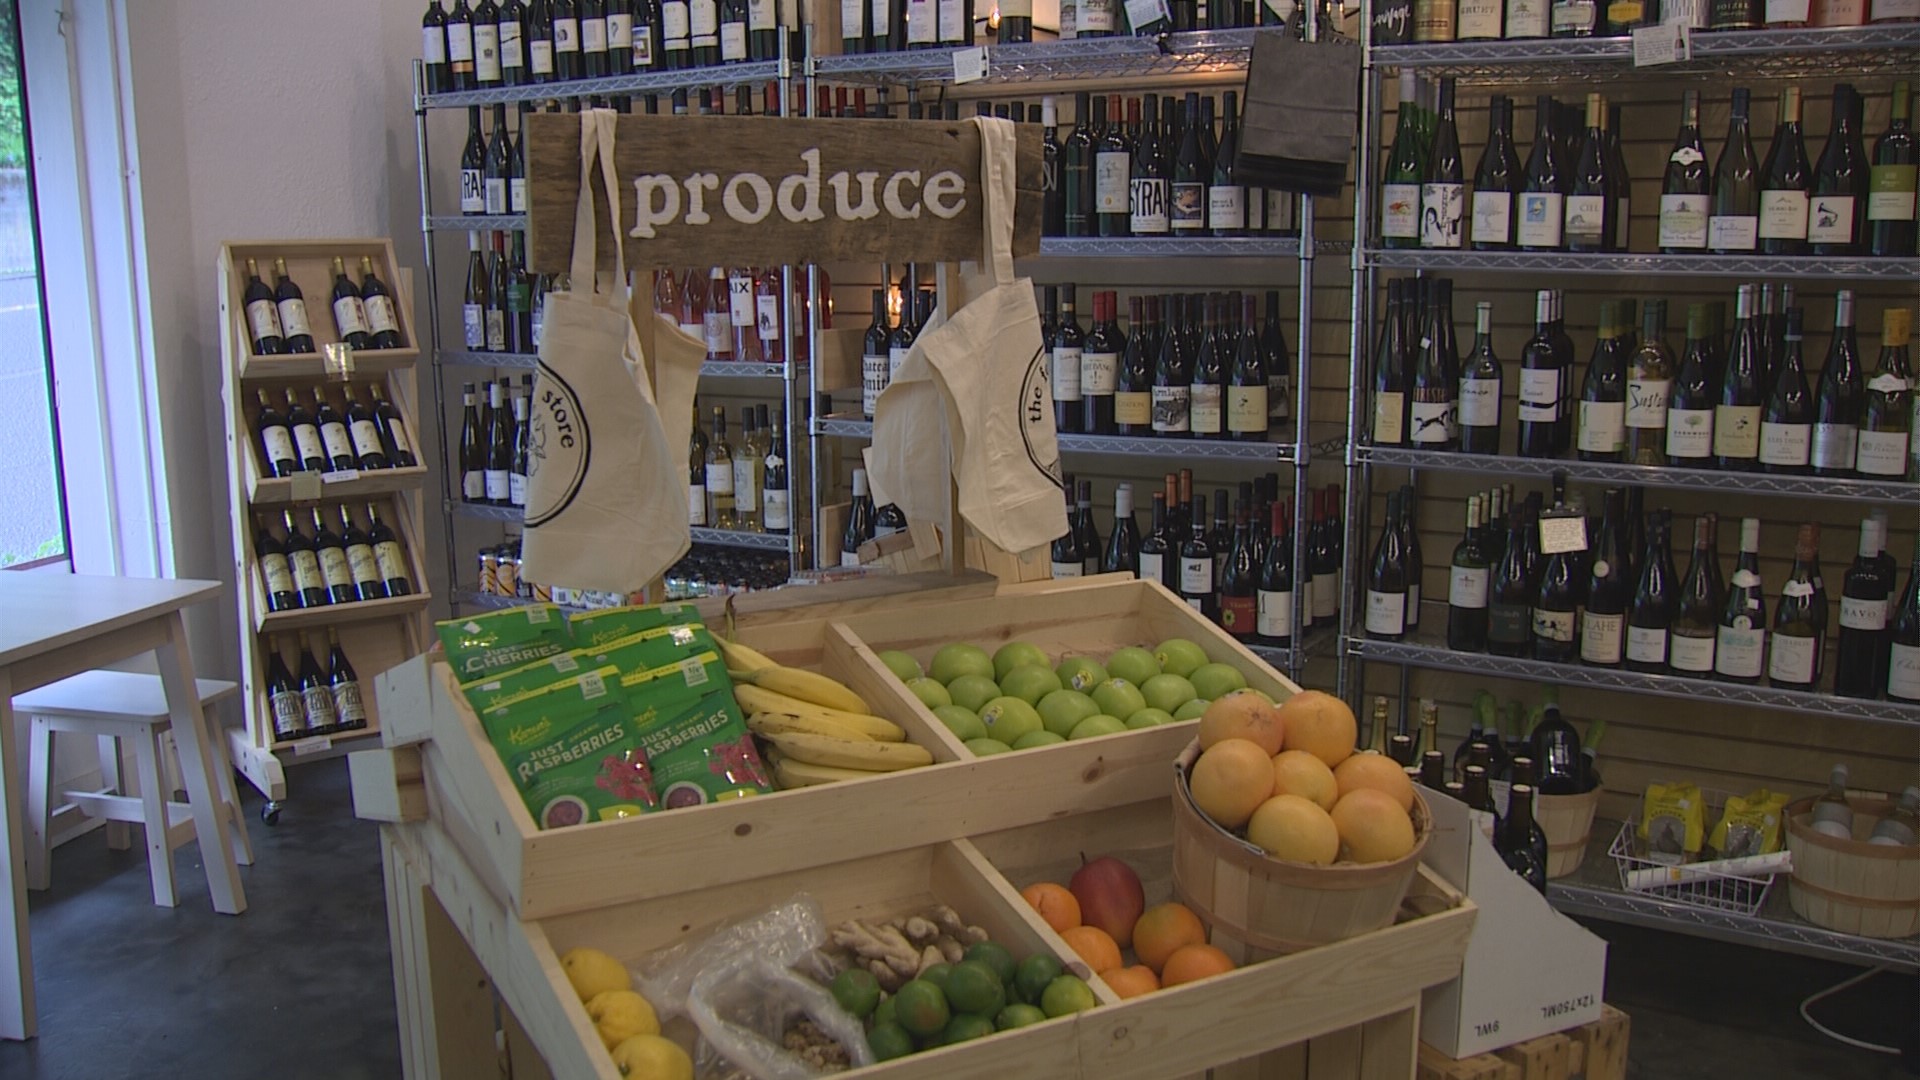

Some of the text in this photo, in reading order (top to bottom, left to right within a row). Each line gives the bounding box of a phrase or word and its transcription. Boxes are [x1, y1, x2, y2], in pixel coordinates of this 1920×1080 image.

[629, 147, 967, 239] produce
[541, 390, 574, 449] store
[1028, 386, 1043, 424] the
[465, 643, 563, 674] CHERRIES
[483, 646, 518, 658] JUST
[640, 726, 673, 747] JUST
[645, 709, 729, 759] ASPBERRIES
[517, 722, 625, 783] RASPBERRIES
[529, 740, 565, 761] JUST
[1541, 993, 1595, 1019] 12x750ML
[1474, 1019, 1500, 1037] 9WL
